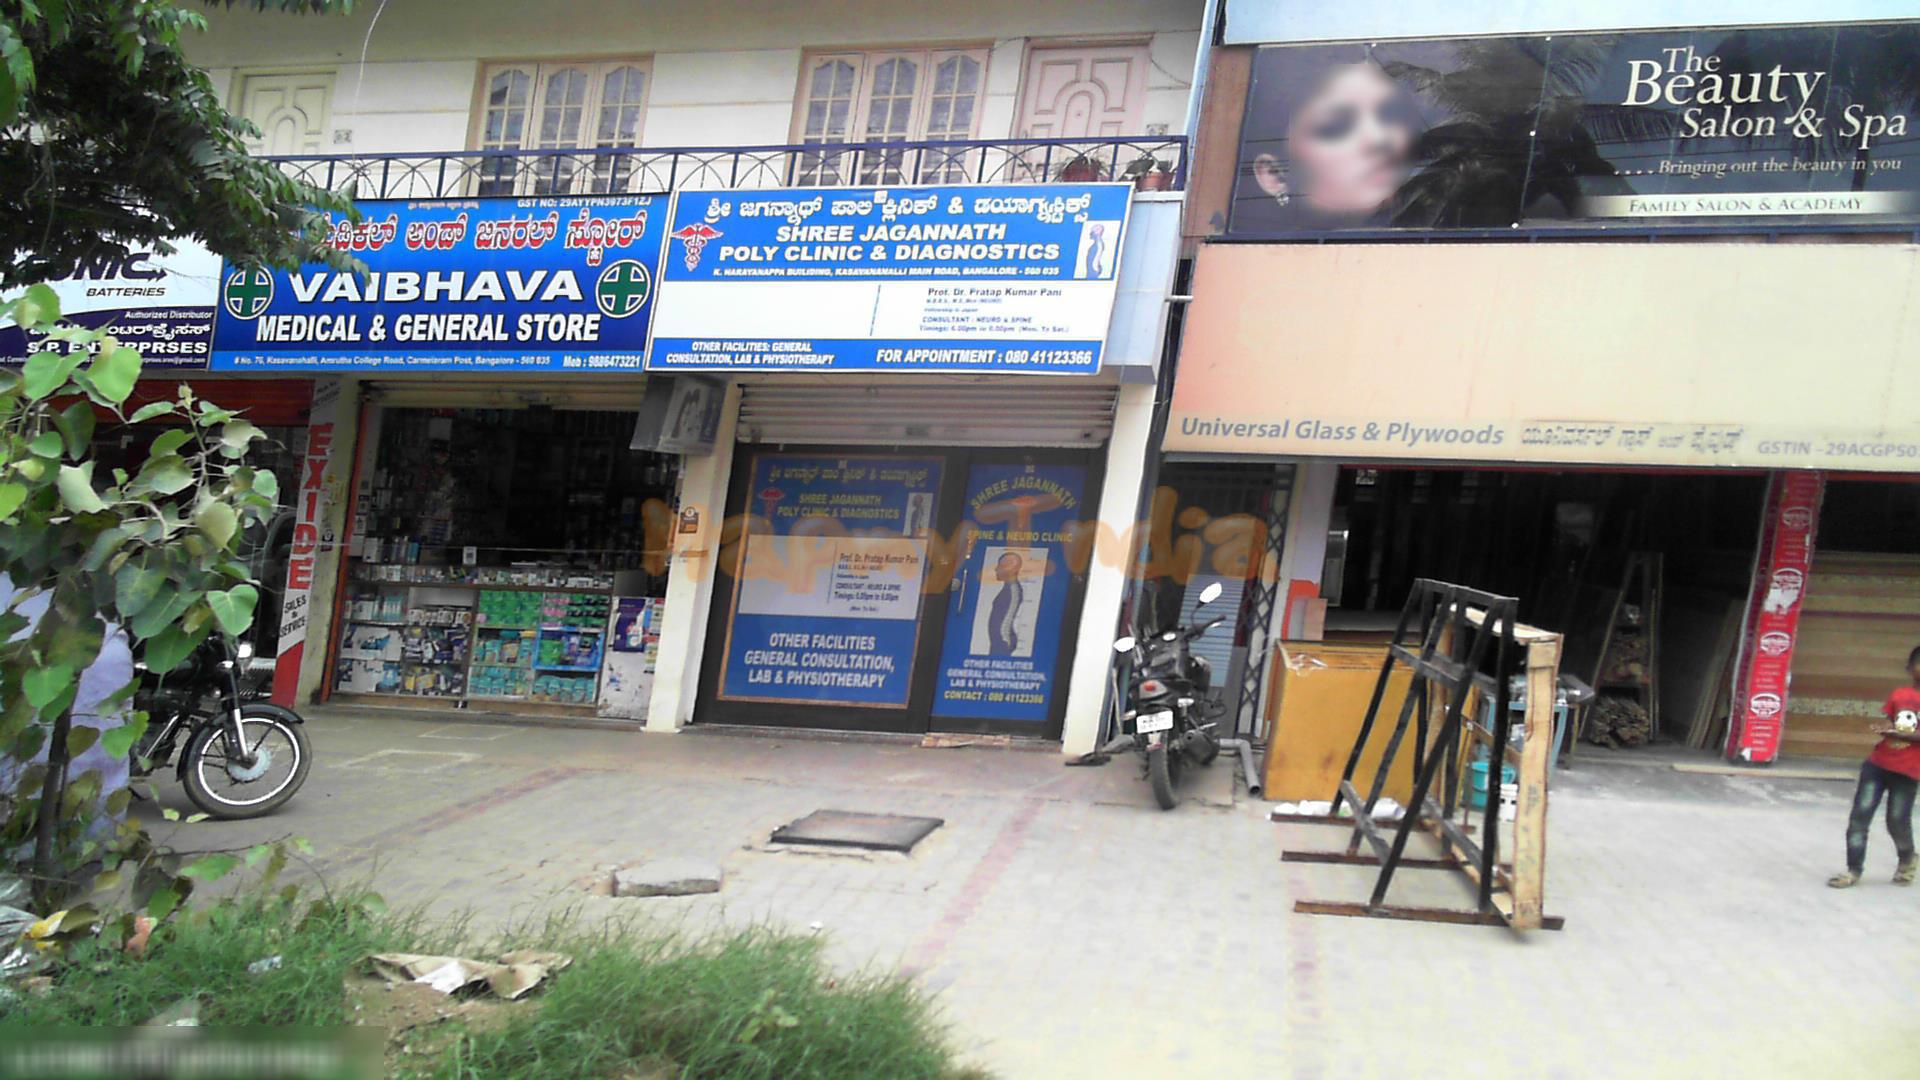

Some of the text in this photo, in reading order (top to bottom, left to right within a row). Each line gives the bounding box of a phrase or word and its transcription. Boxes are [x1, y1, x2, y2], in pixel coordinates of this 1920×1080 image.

[1663, 45, 1721, 73] The
[1621, 59, 1826, 125] Beauty
[1679, 104, 1907, 150] Salon & Spa
[1730, 161, 1757, 173] out
[1762, 158, 1787, 172] the
[1793, 158, 1846, 179] beauty
[1851, 156, 1866, 171] in
[1869, 159, 1902, 178] you
[517, 199, 537, 208] GST
[704, 198, 731, 224] ಶ್ರೀ
[948, 196, 964, 214] &
[1629, 197, 1863, 213] FAMILY SALON & ACADEMY
[404, 212, 468, 251] ಅಂಡ್
[474, 210, 560, 250] ಜನರಲ್
[776, 223, 1007, 243] SHREE JAGANNATH
[718, 244, 1060, 263] POLY CLINIC & DIAGNOSTICS
[86, 287, 166, 297] BATTERIES
[288, 268, 585, 302] VAIBHAVA
[1004, 288, 1037, 296] Kumar
[255, 313, 601, 342] MEDICAL & GENERAL STORE
[692, 341, 722, 352] OTHER
[772, 342, 812, 353] GENERAL
[876, 349, 902, 363] FOR
[904, 348, 996, 364] APPOINTMENT
[1005, 350, 1028, 364] 080
[563, 355, 582, 368] Mob
[734, 354, 753, 365] LAB
[754, 354, 761, 364] &
[1181, 416, 1290, 440] Universal
[1295, 419, 1356, 441] Glass
[1362, 422, 1380, 441] &
[1386, 422, 1504, 448] Plywoods
[1758, 440, 1811, 456] GSTIN
[970, 476, 1077, 510] SHREE JAGANNATH
[287, 422, 335, 591] EXIDE
[769, 632, 876, 651] OTHER FACILITIES
[744, 650, 895, 673] GENERAL CONSULTATION,
[748, 669, 886, 688] LAB & PHYSIOTHERAPY
